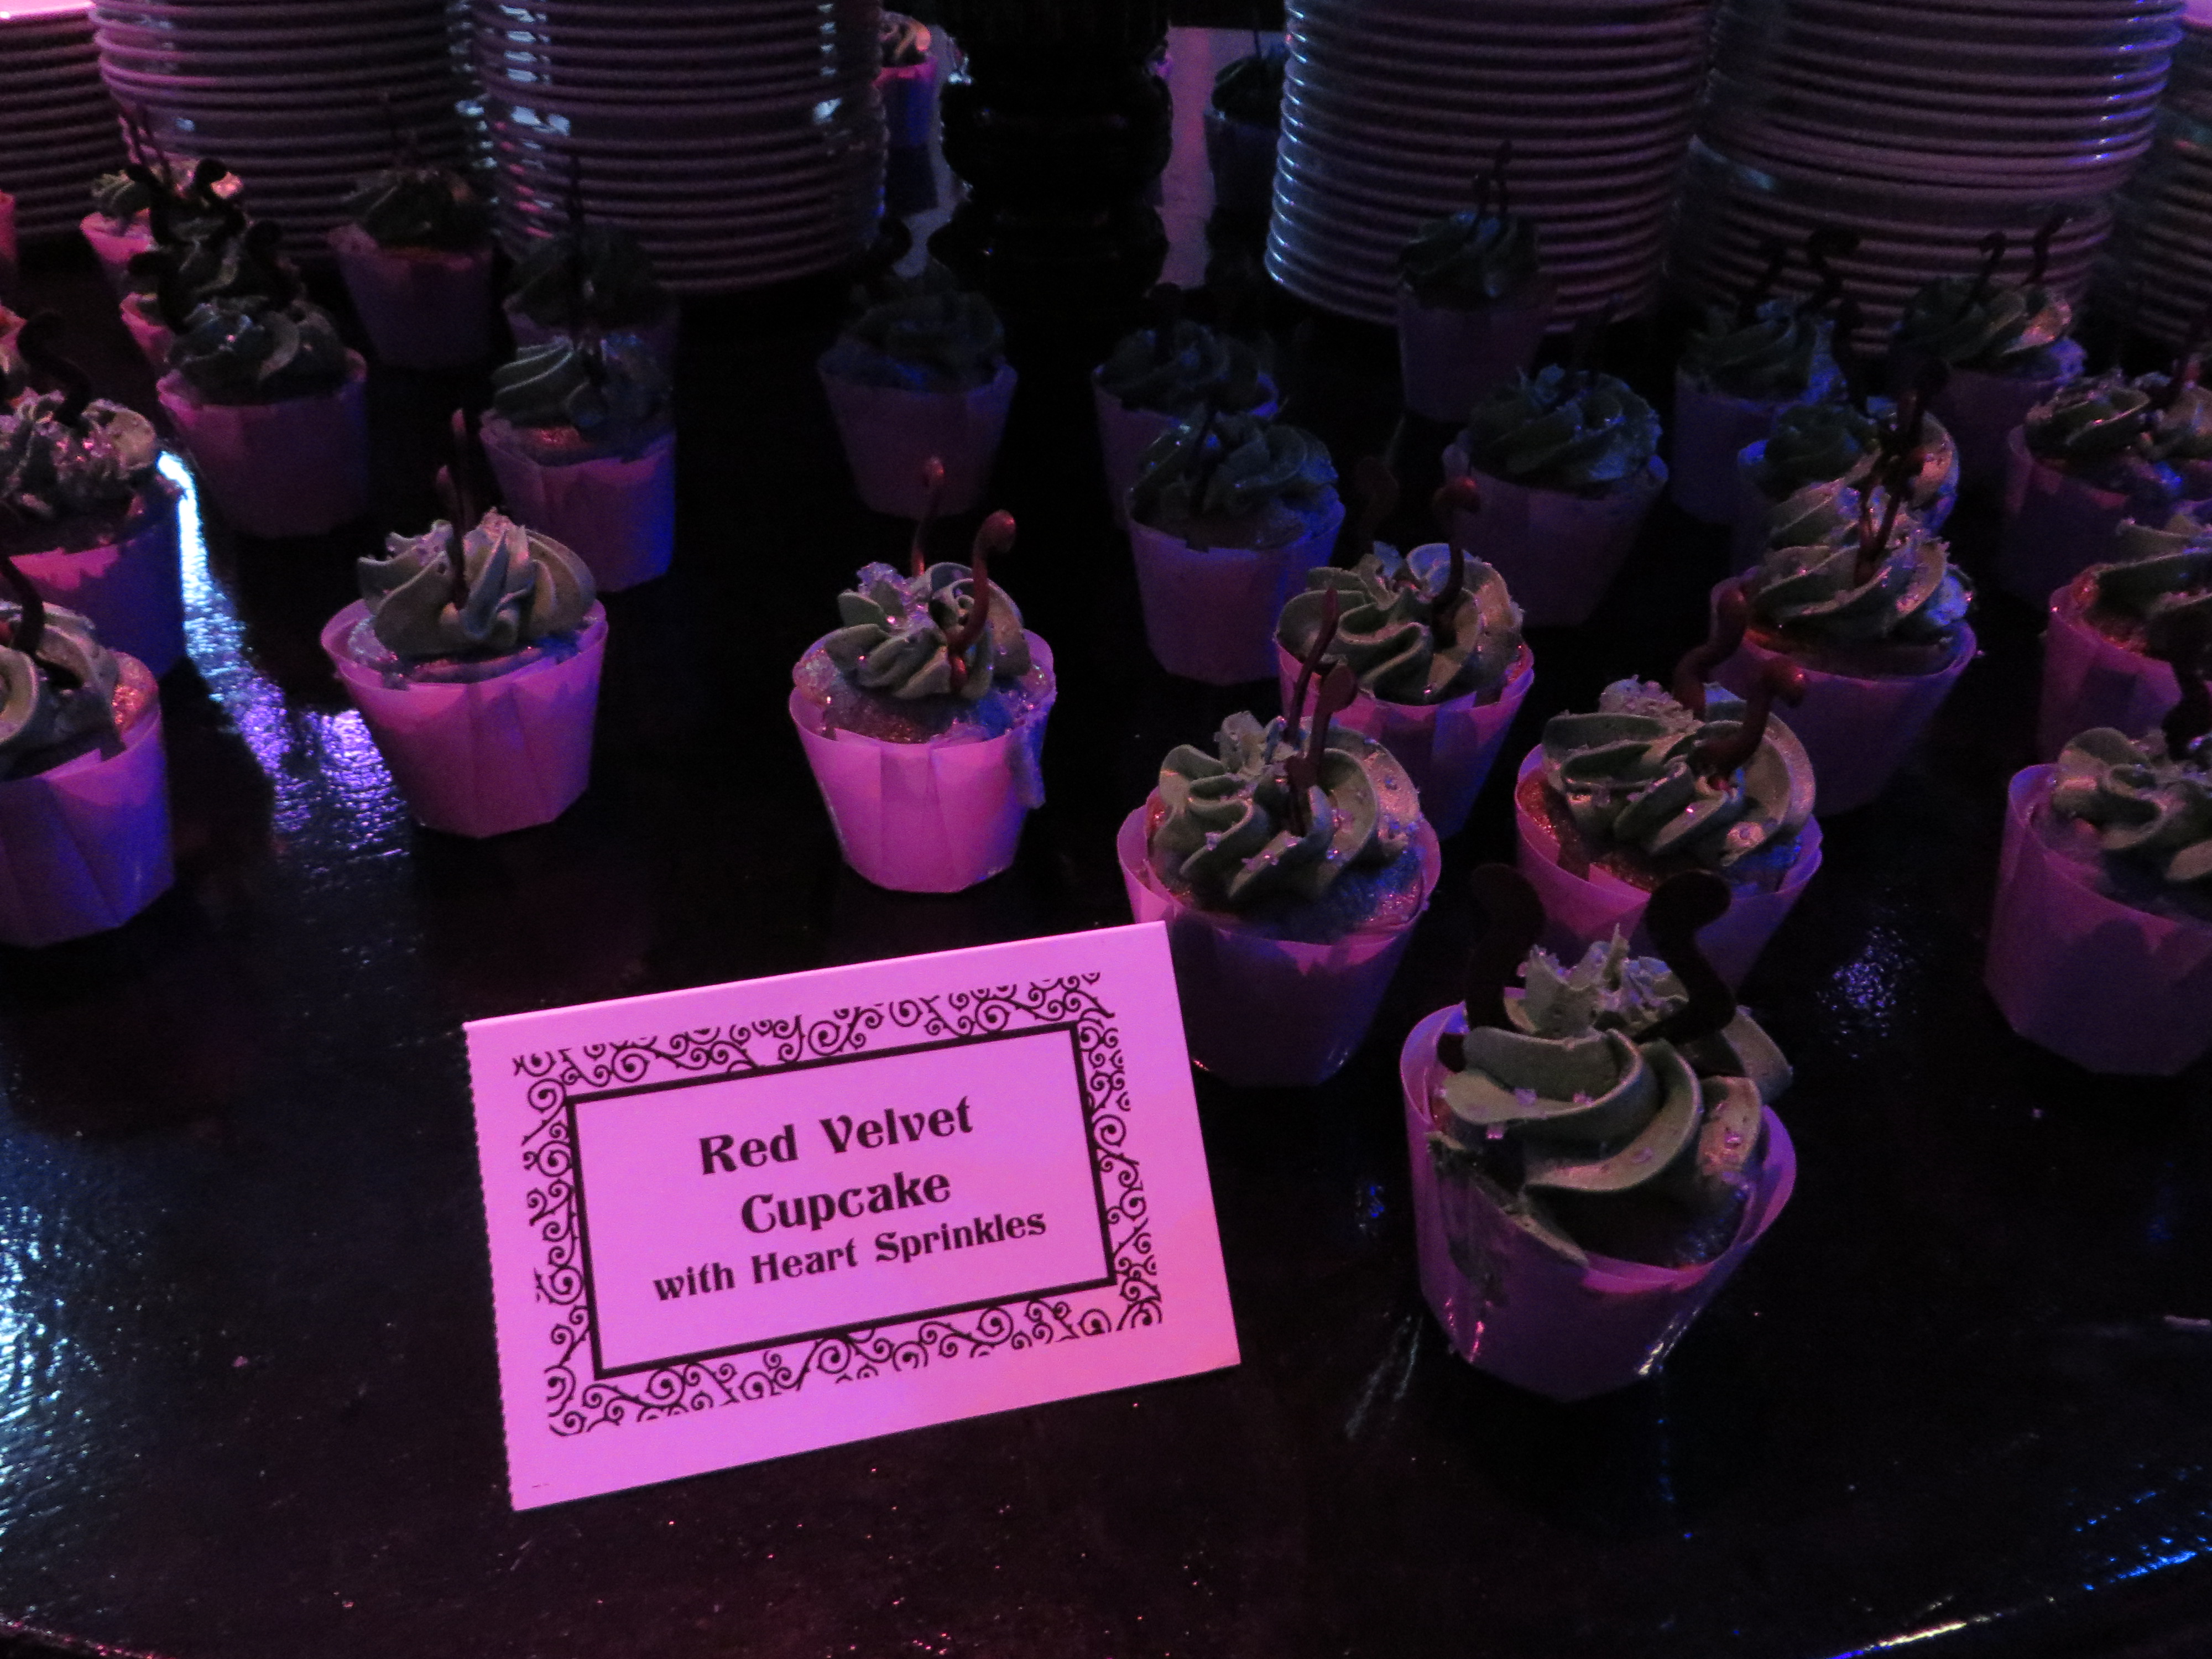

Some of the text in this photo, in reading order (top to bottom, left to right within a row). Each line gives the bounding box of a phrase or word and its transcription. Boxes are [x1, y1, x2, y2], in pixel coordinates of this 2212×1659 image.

[699, 1095, 973, 1175] Red Velvet
[741, 1171, 951, 1234] Cupcake
[653, 1213, 1046, 1301] with Heart Sprinkles
